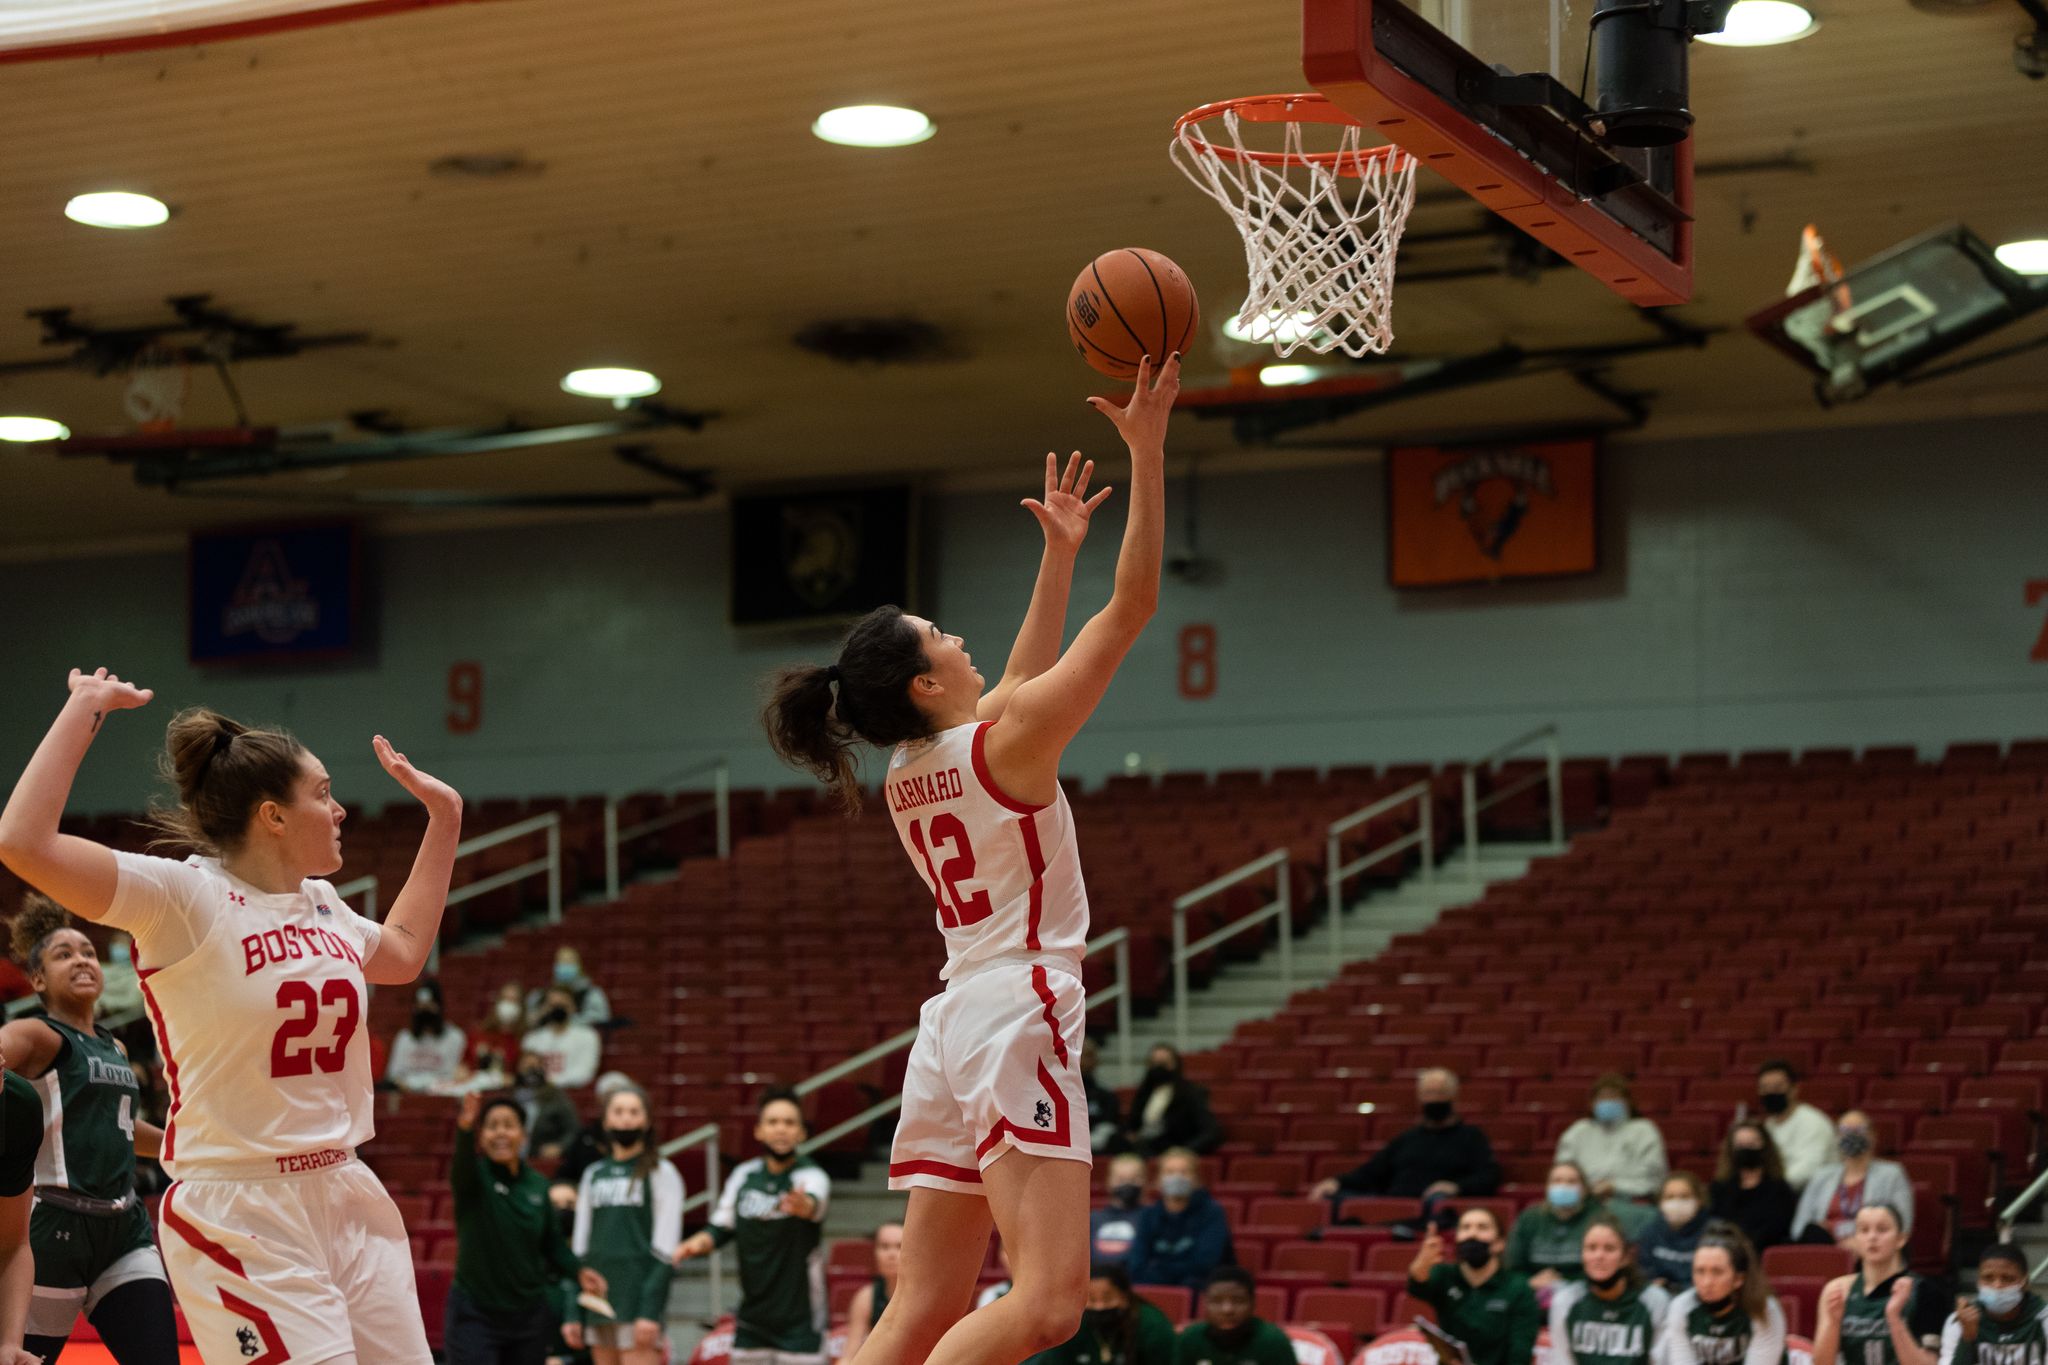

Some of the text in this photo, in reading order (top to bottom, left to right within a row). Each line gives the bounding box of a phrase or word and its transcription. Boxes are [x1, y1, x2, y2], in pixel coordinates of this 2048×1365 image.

[1177, 623, 1217, 700] 8
[446, 661, 483, 733] 9
[888, 767, 963, 813] LARNARD
[909, 813, 994, 929] 12
[242, 924, 363, 976] BOSTON
[271, 979, 359, 1078] 23
[117, 1094, 135, 1142] 4
[275, 1149, 347, 1174] TERRIERS
[1571, 1321, 1645, 1356] LOYOLA
